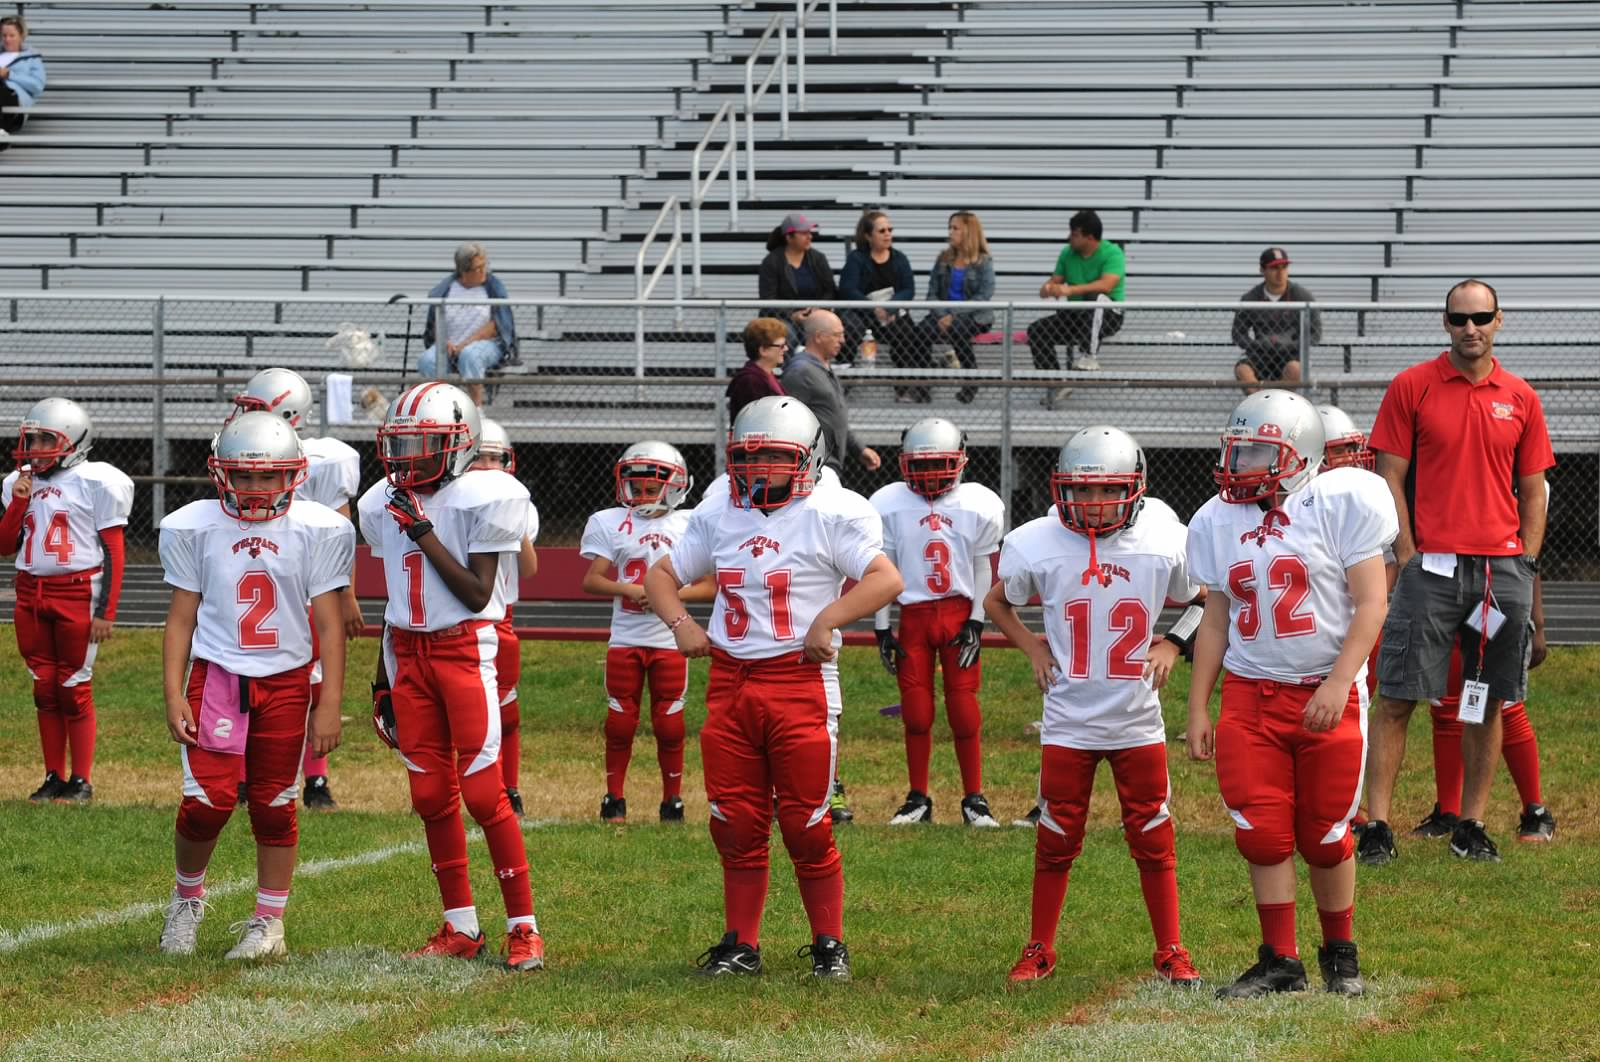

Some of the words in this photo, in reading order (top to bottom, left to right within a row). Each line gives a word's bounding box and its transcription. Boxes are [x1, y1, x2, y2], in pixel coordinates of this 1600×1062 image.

[24, 510, 74, 567] 14
[232, 536, 279, 555] WOLFPACK
[924, 538, 953, 597] 3
[237, 570, 279, 650] 2
[402, 549, 427, 628] 1
[717, 568, 796, 641] 51
[1228, 554, 1317, 641] 52
[1065, 598, 1150, 680] 12
[213, 717, 233, 738] 2
